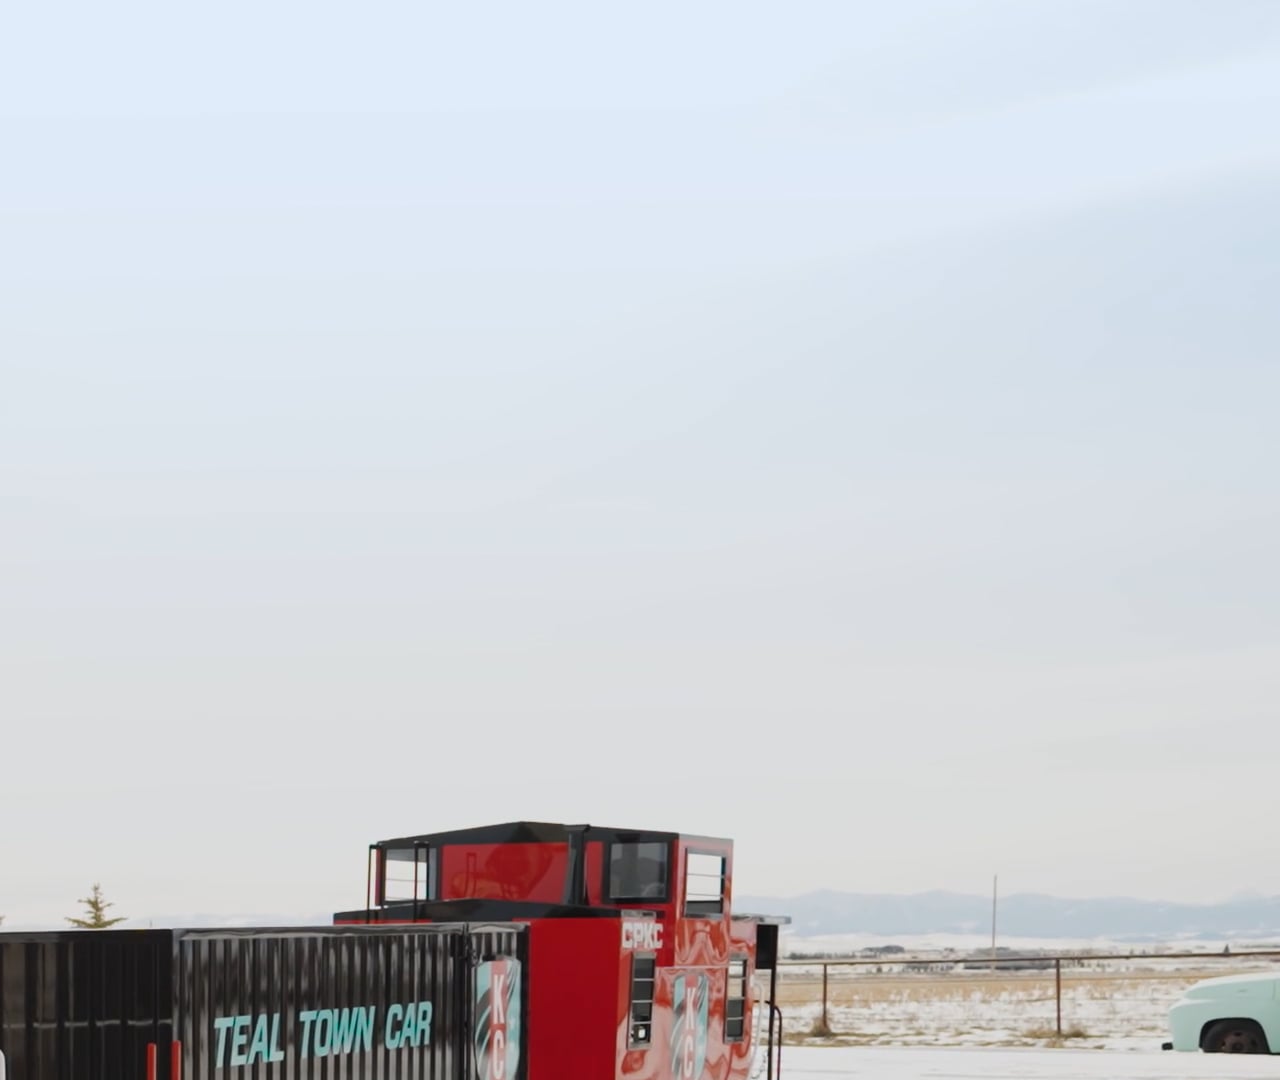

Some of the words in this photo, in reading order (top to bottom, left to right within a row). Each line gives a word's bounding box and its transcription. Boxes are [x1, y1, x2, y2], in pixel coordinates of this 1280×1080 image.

[621, 922, 664, 949] CPKC
[214, 1013, 284, 1069] TEAL
[299, 1005, 376, 1059] TOWN
[385, 1001, 433, 1050] CAR
